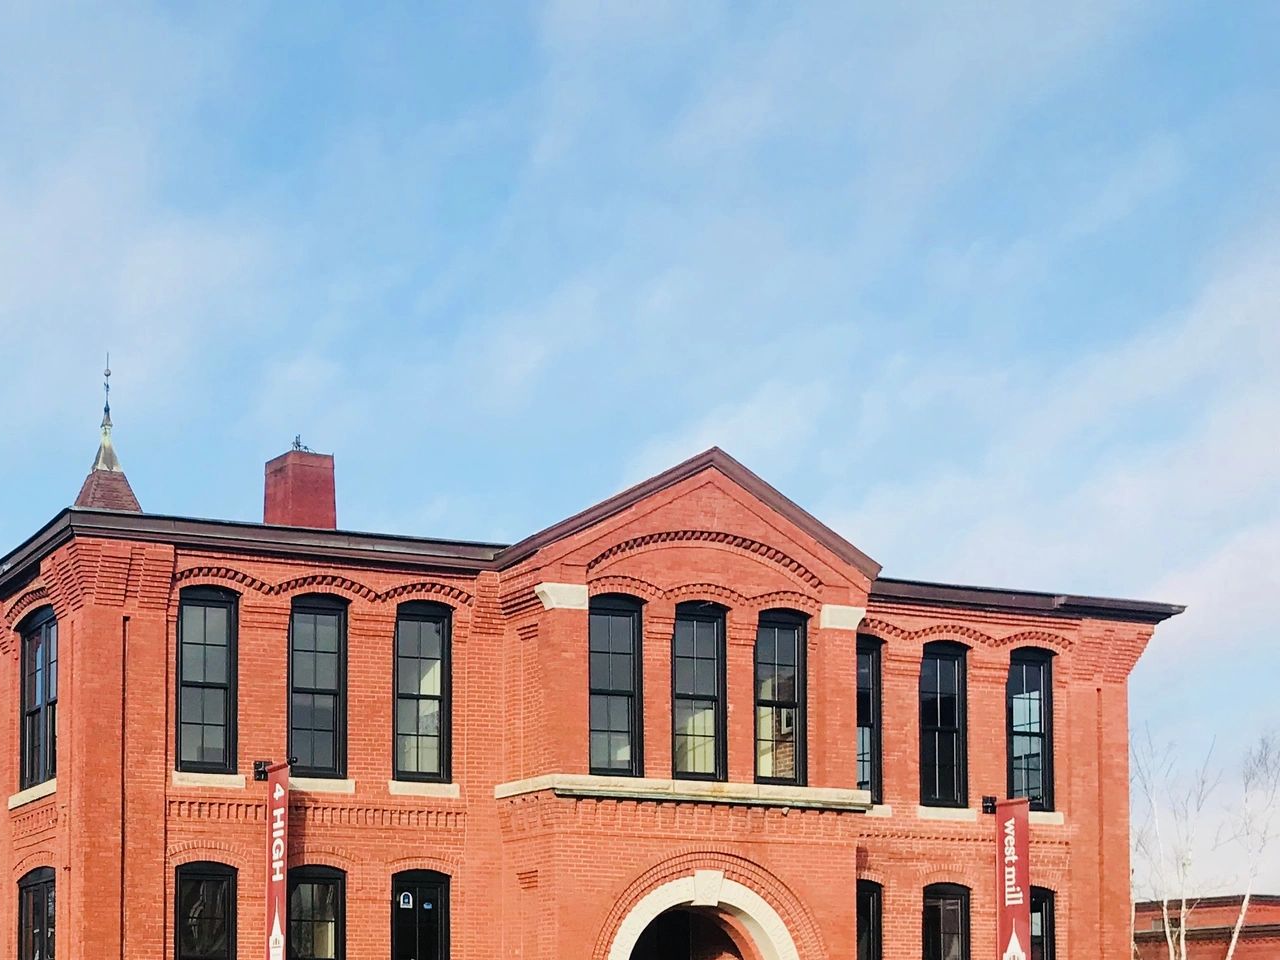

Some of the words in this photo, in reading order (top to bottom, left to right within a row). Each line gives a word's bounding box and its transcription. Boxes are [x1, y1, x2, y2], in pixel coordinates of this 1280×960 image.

[273, 783, 284, 800] 4
[272, 808, 284, 882] HIGH
[1004, 817, 1018, 864] west
[1005, 866, 1023, 906] mill
